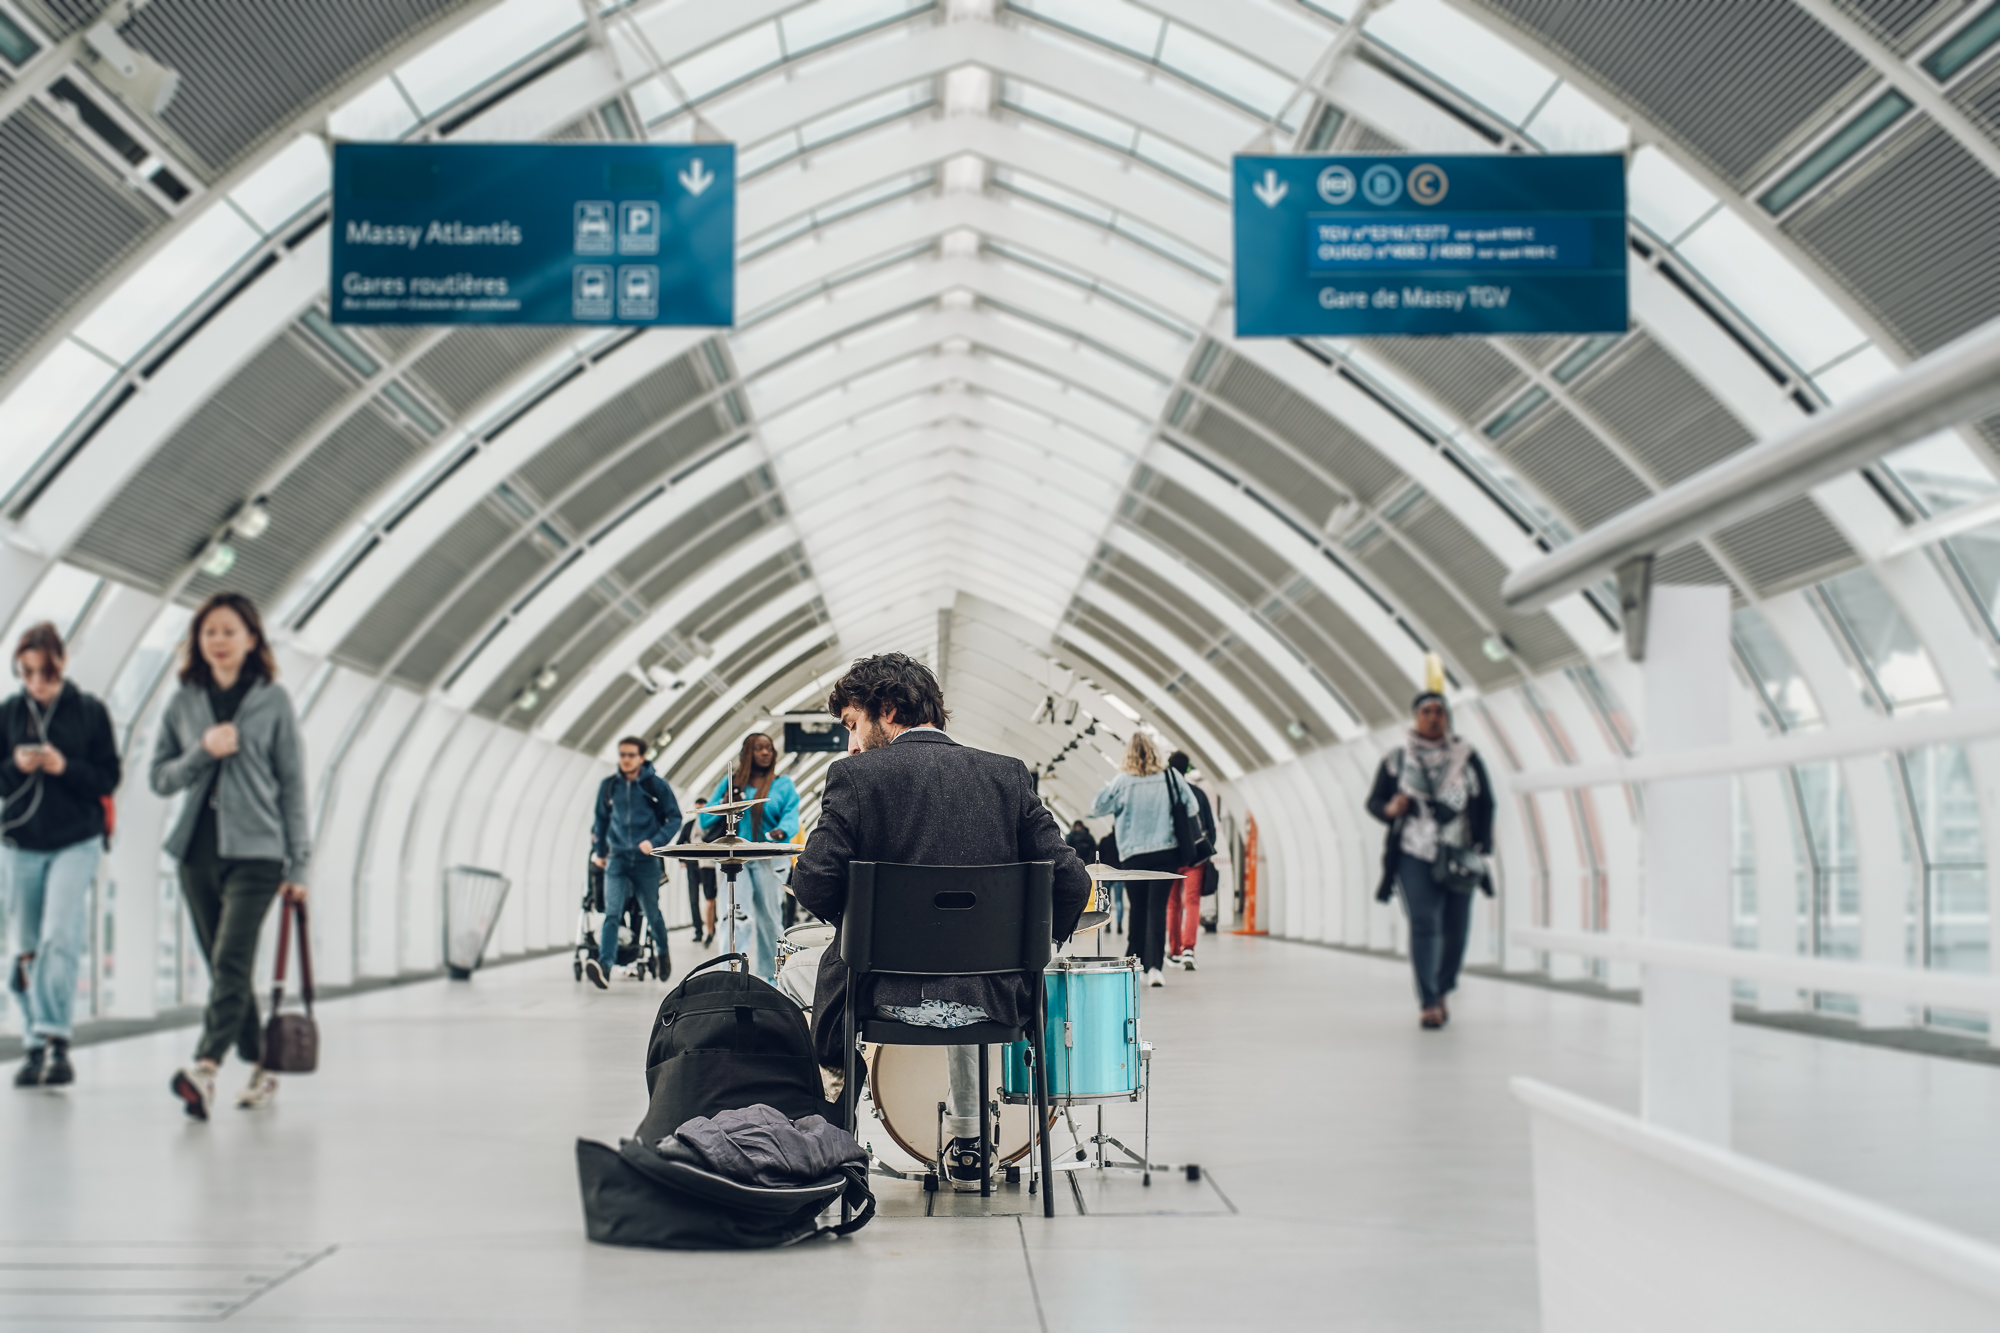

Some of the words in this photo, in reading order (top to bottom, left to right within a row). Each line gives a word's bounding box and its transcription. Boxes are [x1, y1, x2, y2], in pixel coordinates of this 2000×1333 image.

[628, 209, 650, 233] P
[346, 220, 422, 250] Massy
[425, 220, 522, 245] Atlantis
[1318, 225, 1351, 241] TGV
[1318, 243, 1373, 260] OUIGO
[343, 272, 406, 295] Gares
[409, 273, 509, 295] routières
[1319, 288, 1367, 308] Gare
[1372, 287, 1397, 308] de
[1402, 288, 1465, 311] Massy
[1467, 286, 1510, 307] TGV
